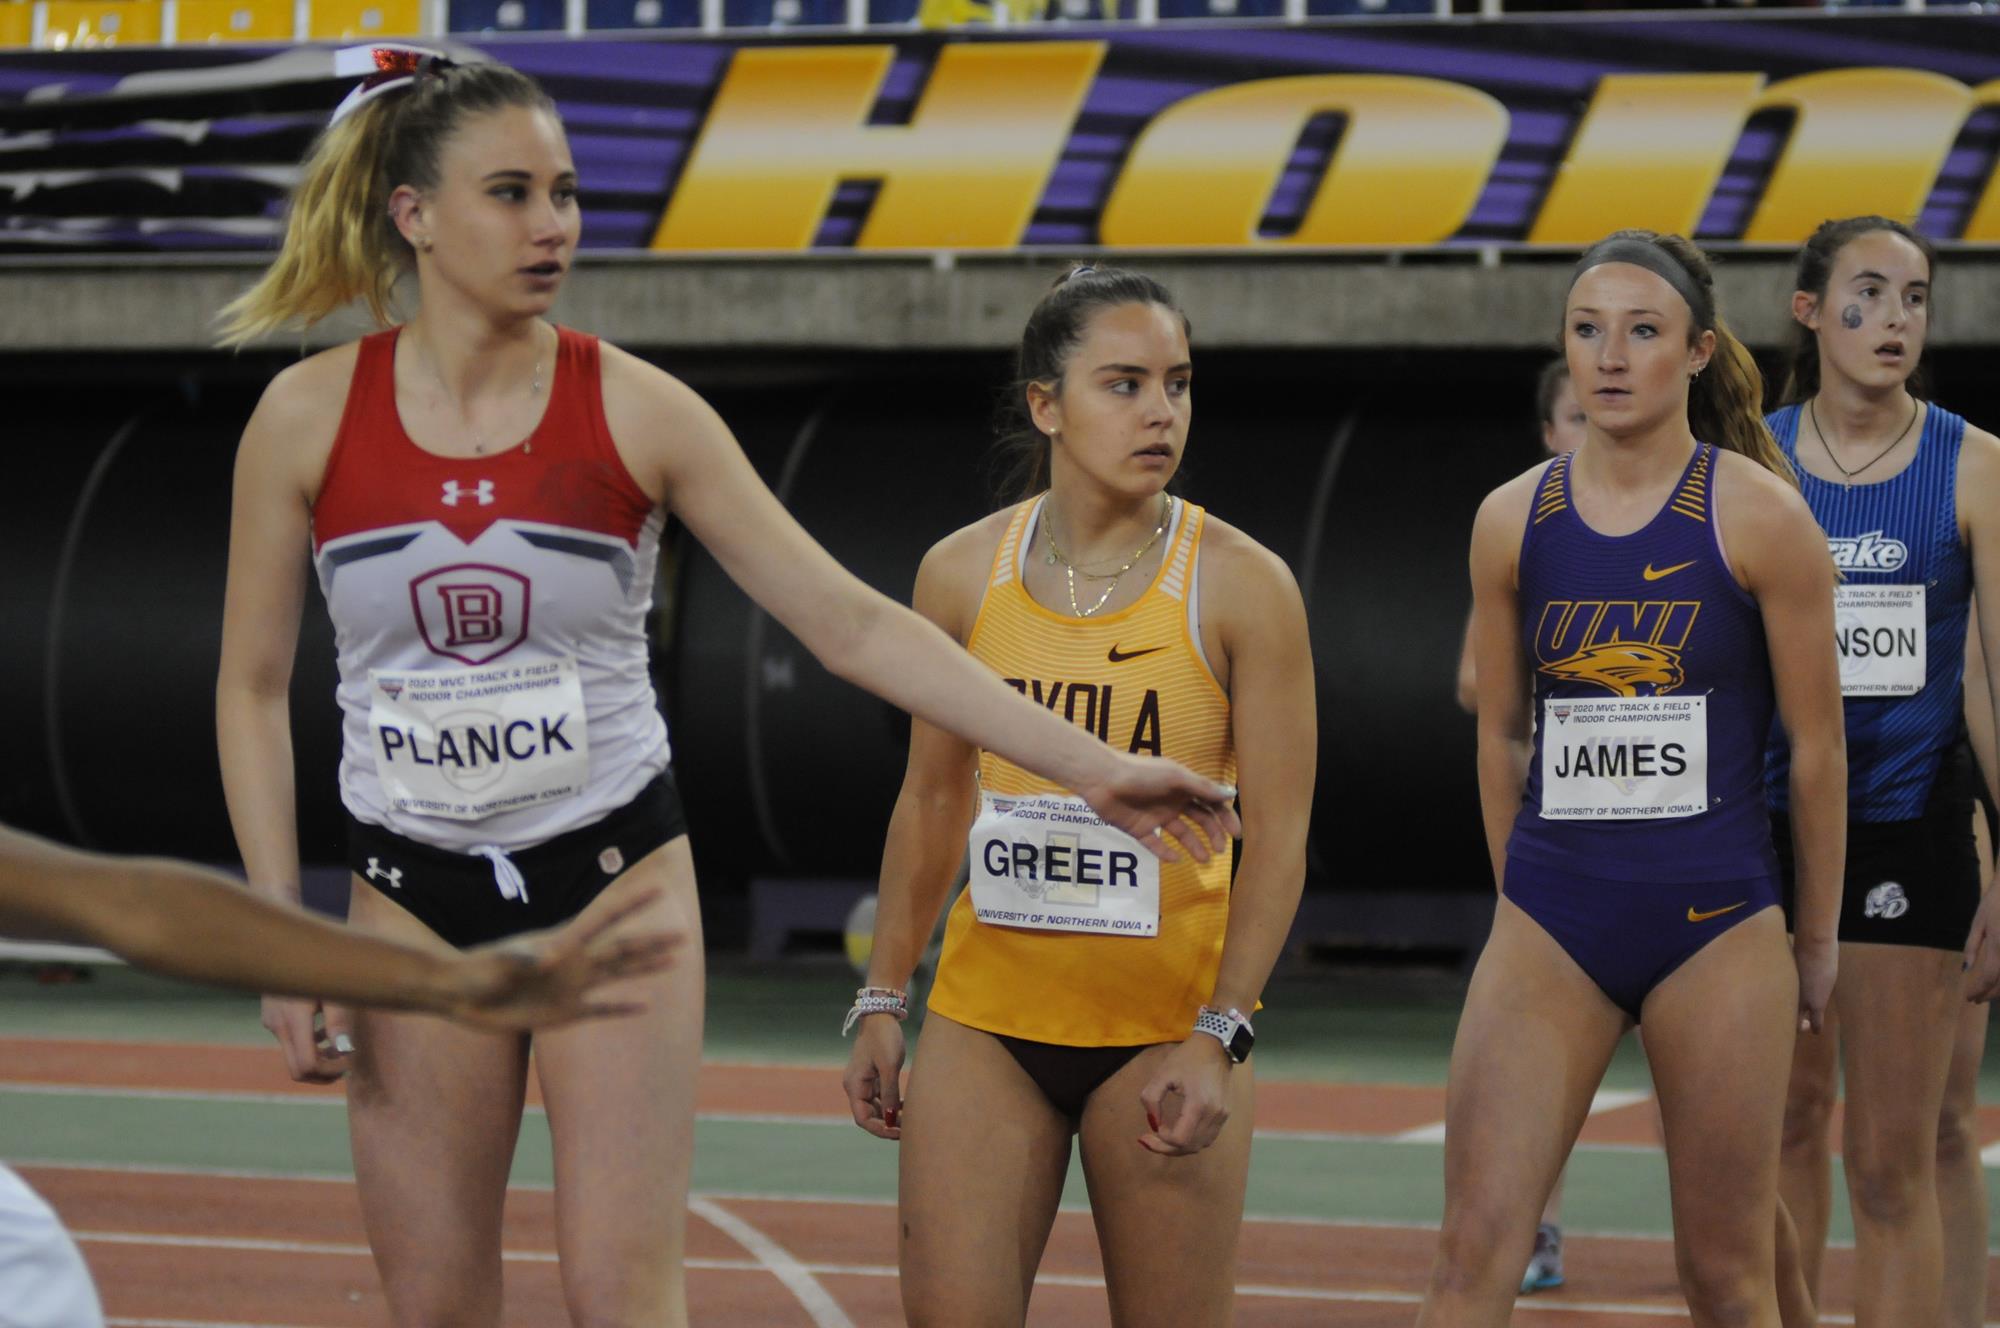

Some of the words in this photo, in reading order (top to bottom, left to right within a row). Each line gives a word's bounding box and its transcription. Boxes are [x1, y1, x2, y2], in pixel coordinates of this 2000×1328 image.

[1837, 600, 1914, 609] CHAMPIONSHIPS
[1848, 591, 1877, 599] TRACK
[1888, 591, 1913, 599] FIELD
[437, 584, 502, 647] B
[1535, 601, 1701, 666] UNI
[408, 678, 436, 688] 2020
[439, 676, 465, 687] MVC
[470, 672, 509, 685] TRACK
[512, 668, 521, 677] &
[525, 663, 559, 676] FIELD
[408, 691, 451, 701] INDOOR
[455, 676, 561, 700] CHAMPIONSHIPS
[1890, 684, 1914, 692] IOWA
[1573, 704, 1594, 713] 2020
[1596, 704, 1616, 713] MVC
[1620, 703, 1650, 712] TRACK
[1653, 703, 1660, 711] &
[1663, 702, 1691, 711] FIELD
[1573, 714, 1605, 724] INDOOR
[1608, 713, 1692, 723] CHAMPIONSHIPS
[379, 713, 574, 768] PLANCK
[1555, 742, 1688, 778] JAMES
[393, 797, 452, 812] UNIVERSITY
[454, 804, 468, 814] OF
[540, 785, 572, 799] IOWA
[1038, 800, 1060, 810] MVC
[1549, 807, 1595, 816] UNIVERSITY
[1597, 807, 1609, 816] OF
[1611, 805, 1665, 815] NORTHERN
[1667, 804, 1693, 814] IOWA
[983, 839, 1139, 888] GREER
[977, 908, 1028, 922] UNIVERSITY
[1030, 914, 1044, 923] OF
[1047, 915, 1109, 928] NORTHERN
[1111, 919, 1142, 930] IOWA
